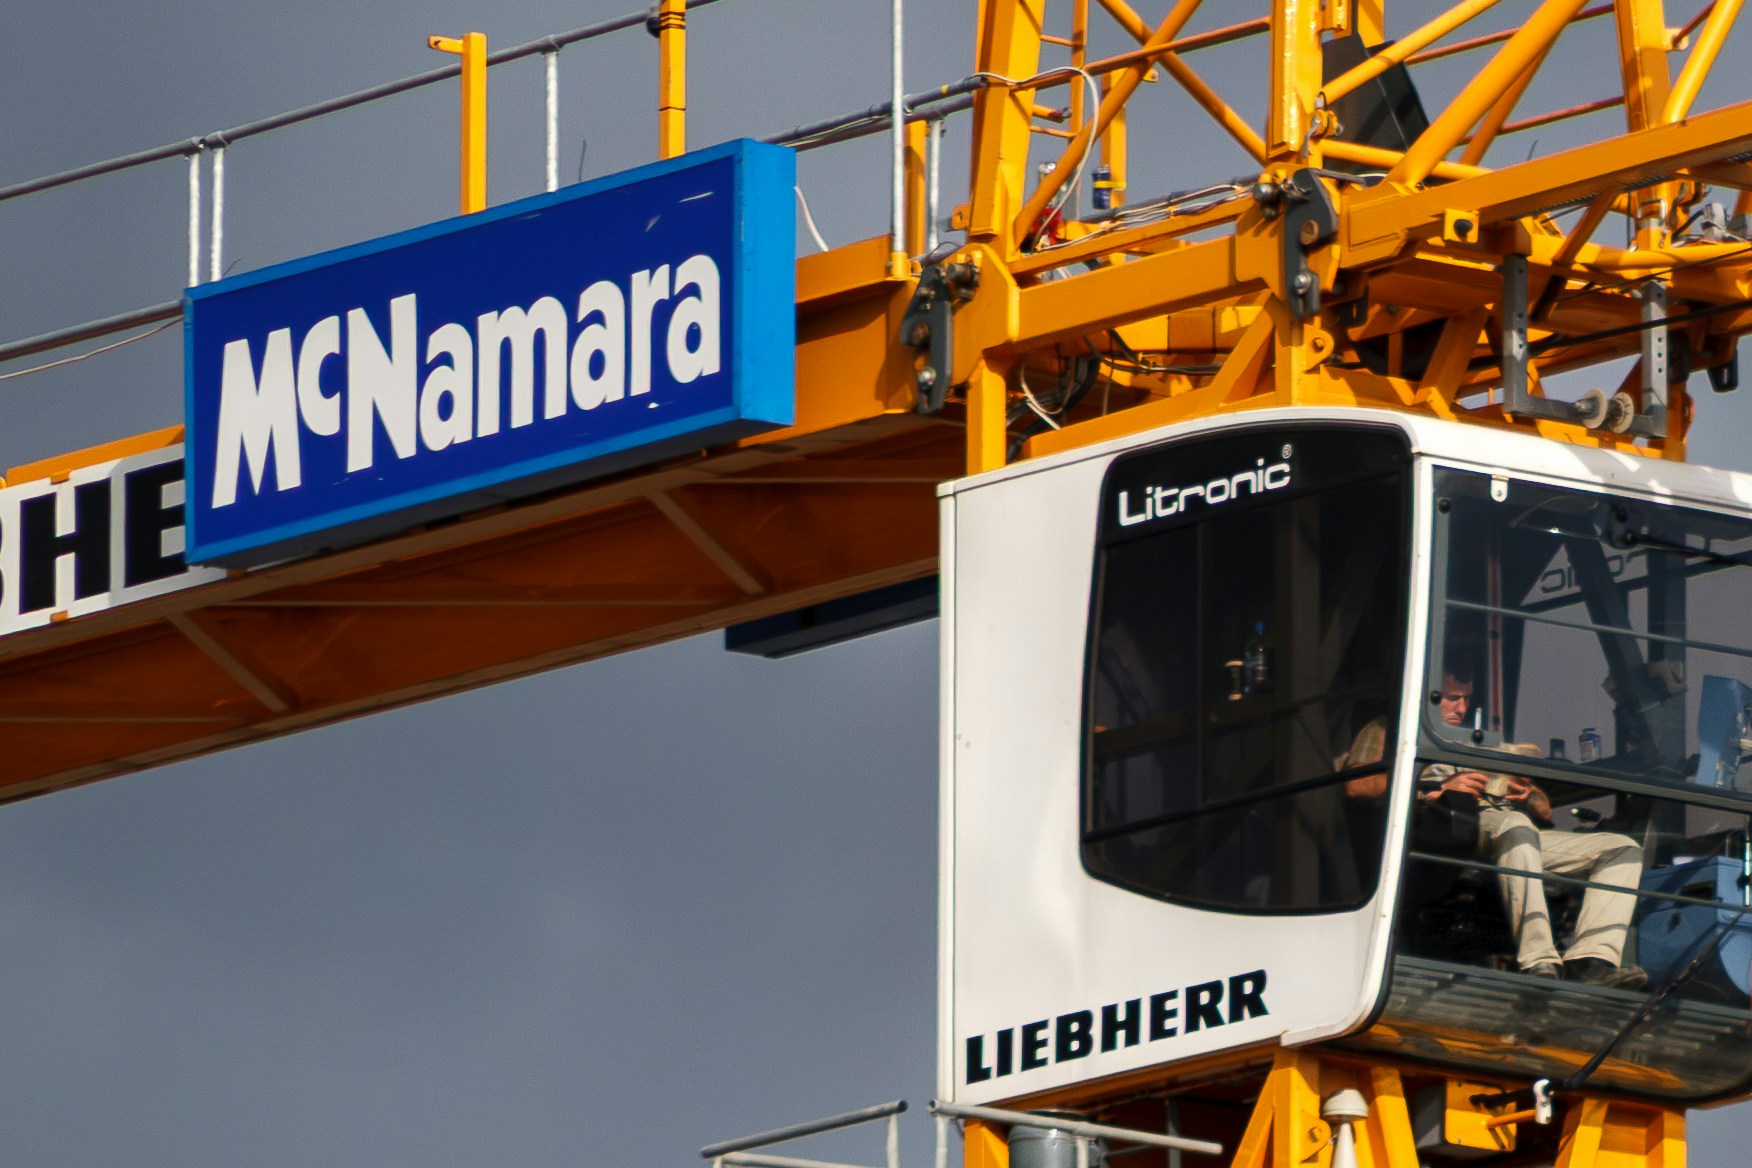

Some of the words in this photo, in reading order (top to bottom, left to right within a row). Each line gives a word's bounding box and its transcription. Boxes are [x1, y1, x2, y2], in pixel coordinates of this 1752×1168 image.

[212, 254, 721, 509] McNamara
[0, 458, 188, 615] HE
[966, 969, 1270, 1085] LIEBHERR
